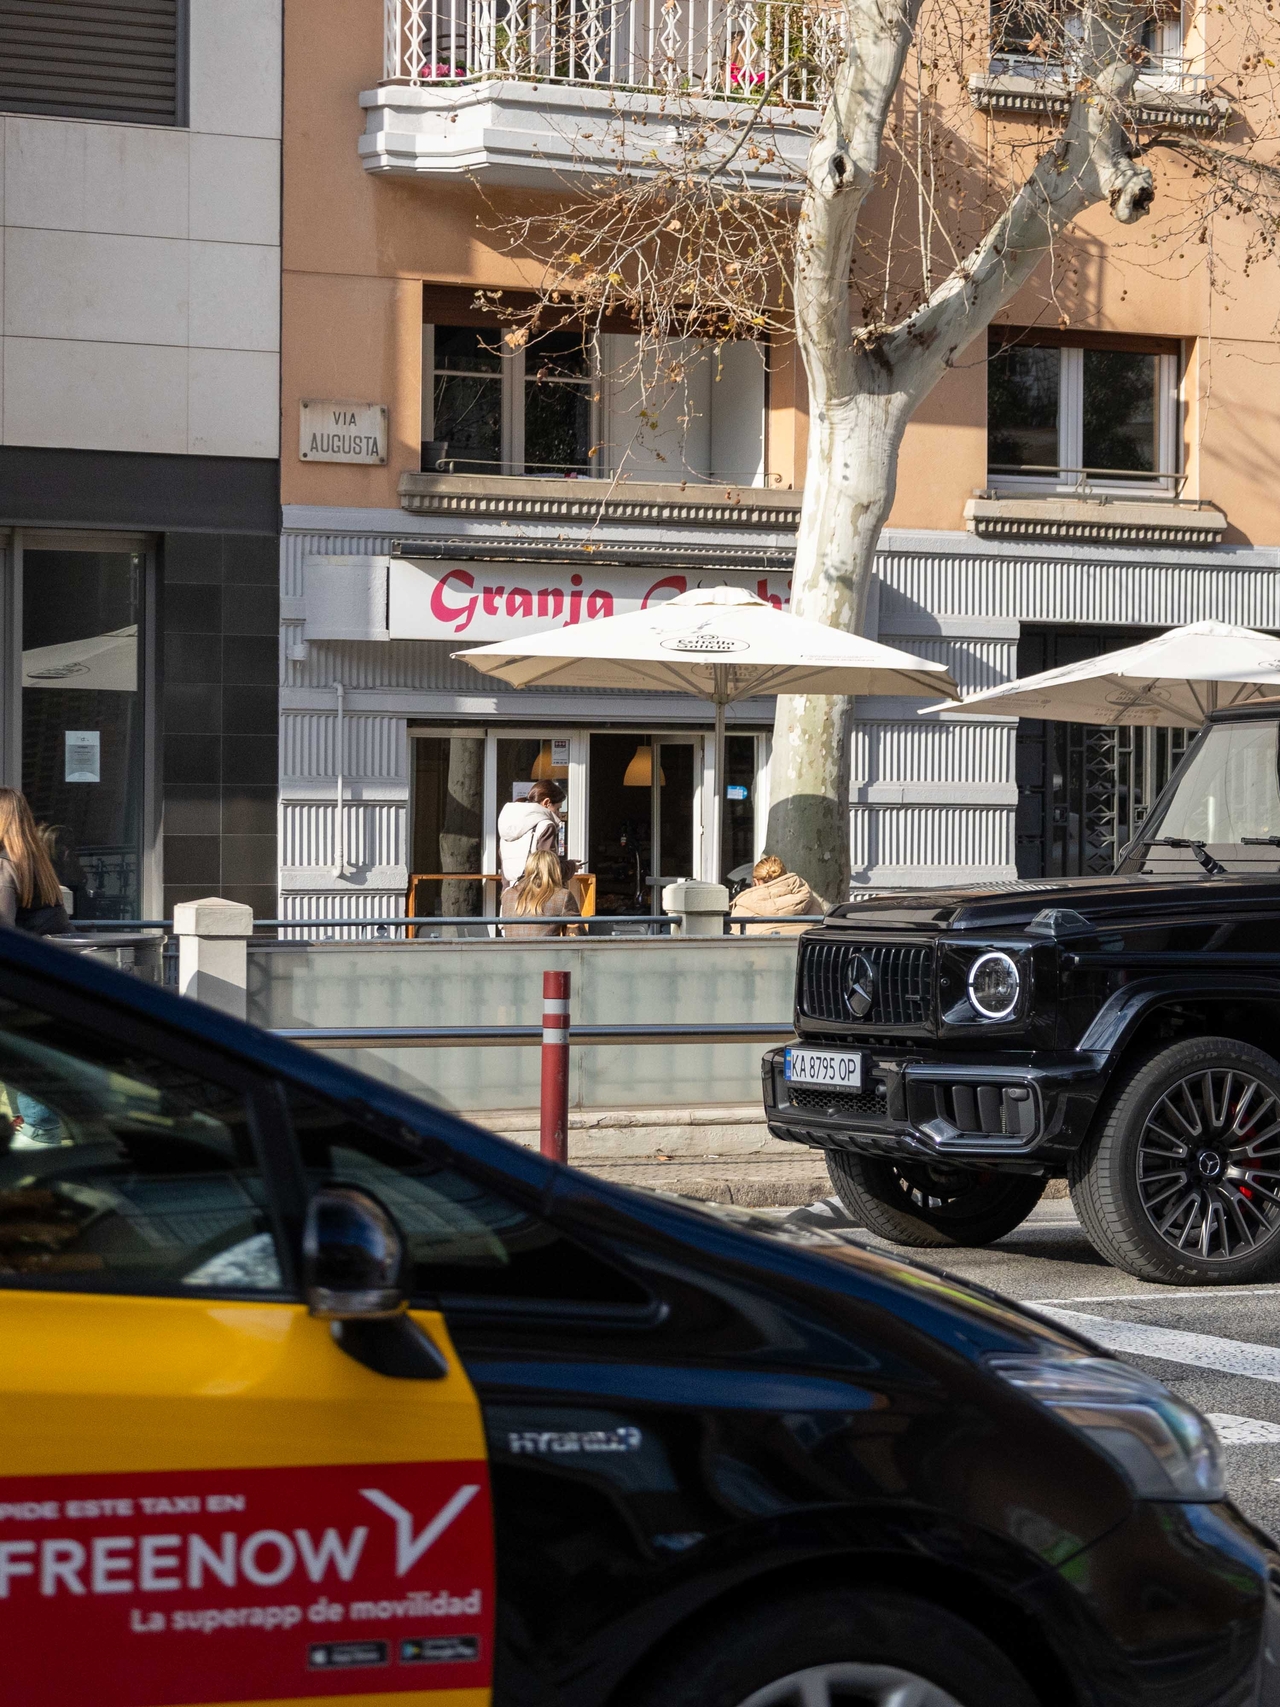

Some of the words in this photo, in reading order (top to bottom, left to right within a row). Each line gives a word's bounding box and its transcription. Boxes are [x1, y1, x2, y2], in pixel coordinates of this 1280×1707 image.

[333, 411, 357, 427] VIA
[310, 432, 379, 457] AUGUSTA
[430, 568, 614, 633] Granja
[792, 1054, 806, 1078] KA
[809, 1056, 836, 1080] 8795
[838, 1058, 857, 1082] OP
[65, 1497, 134, 1520] ESTE
[140, 1496, 201, 1516] TAXI
[206, 1493, 246, 1514] EN
[0, 1526, 369, 1599] FREENOW
[130, 1607, 166, 1634] La
[171, 1604, 302, 1635] superapp
[307, 1596, 344, 1624] de
[350, 1588, 483, 1620] movilidad
